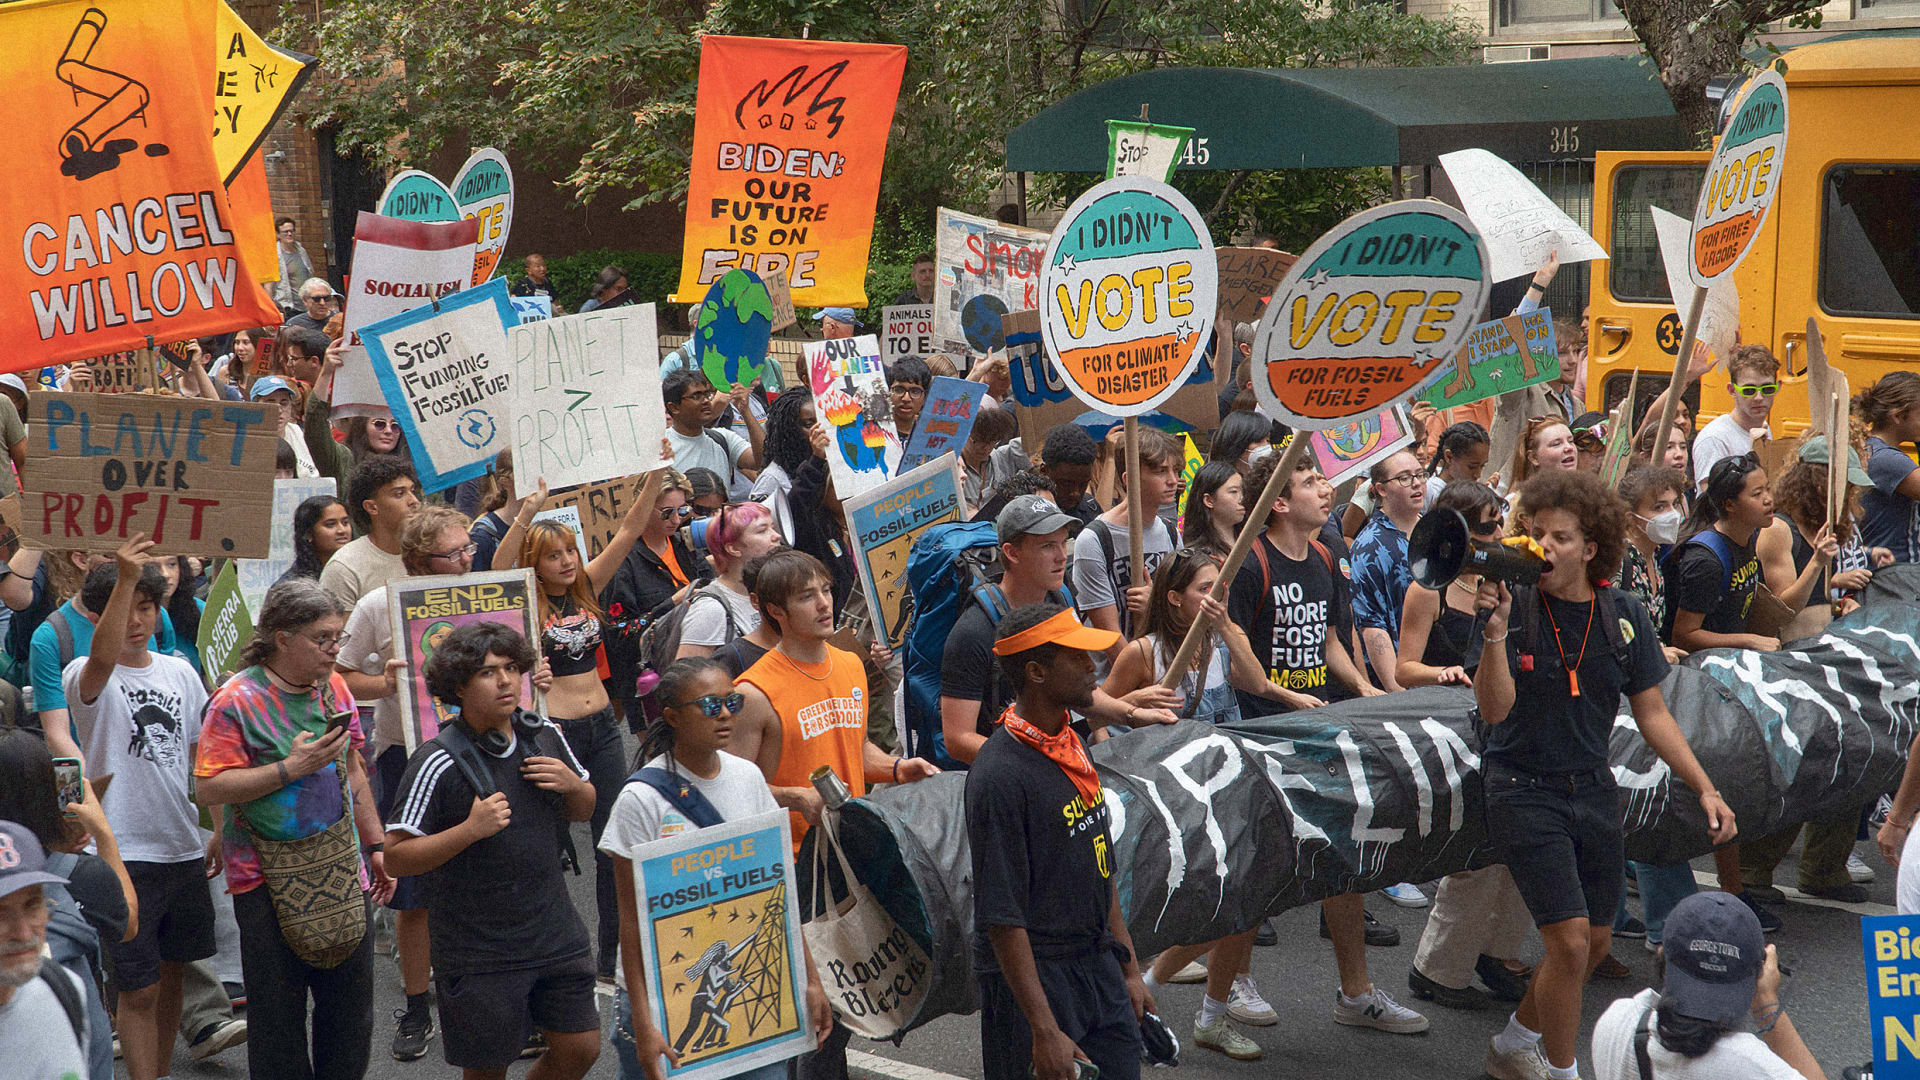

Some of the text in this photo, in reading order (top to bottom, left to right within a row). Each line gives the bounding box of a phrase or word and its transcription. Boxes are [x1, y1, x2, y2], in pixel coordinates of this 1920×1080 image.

[1733, 104, 1777, 138] I DIDN'T
[1177, 138, 1210, 165] 45
[1550, 126, 1579, 153] 345
[718, 141, 846, 178] BIDEN:
[465, 172, 502, 198] DIDN'T
[744, 178, 812, 202] OUR
[1706, 145, 1775, 219] VOTE
[389, 191, 443, 216] I DIDN'T
[711, 198, 829, 224] FUTURE
[23, 190, 235, 276] CANCEL
[729, 225, 808, 246] IS ON
[1078, 212, 1173, 250] I DIDN'T
[1701, 220, 1750, 250] FOR FIRES
[1340, 233, 1462, 266] I DIDN'T
[1707, 242, 1738, 267] FLOODS
[30, 258, 237, 340] WILLOW
[1055, 260, 1194, 340] VOTE
[889, 310, 931, 321] ANIMALS
[889, 322, 915, 335] NOT
[1289, 289, 1462, 350] VOTE
[1469, 313, 1544, 345] STAND FOR
[515, 316, 629, 399] PLANET
[825, 338, 860, 361] OUR
[888, 336, 910, 354] TO
[1470, 325, 1549, 359] I STAND ON
[1082, 354, 1112, 374] FOR
[1116, 342, 1180, 371] CLIMATE
[1097, 366, 1168, 395] DISASTER
[1287, 366, 1404, 385] FOR FOSSIL
[1303, 388, 1370, 407] FUELS
[47, 400, 265, 466] PLANET
[517, 404, 640, 484] PROFIT
[103, 459, 189, 491] OVER
[873, 480, 935, 518] PEOPLE
[860, 493, 958, 547] FOSSIL FUELS
[406, 595, 525, 620] FOSSIL FUELS
[424, 584, 504, 605] END
[1272, 582, 1303, 606] NO
[211, 590, 241, 645] SIERRA
[1274, 600, 1327, 626] MORE
[216, 622, 239, 666] CLUB
[1271, 646, 1323, 668] FUEL
[671, 838, 756, 877] PEOPLE
[648, 862, 785, 914] FOSSIL FUELS
[1690, 939, 1740, 959] GEORGETOWN
